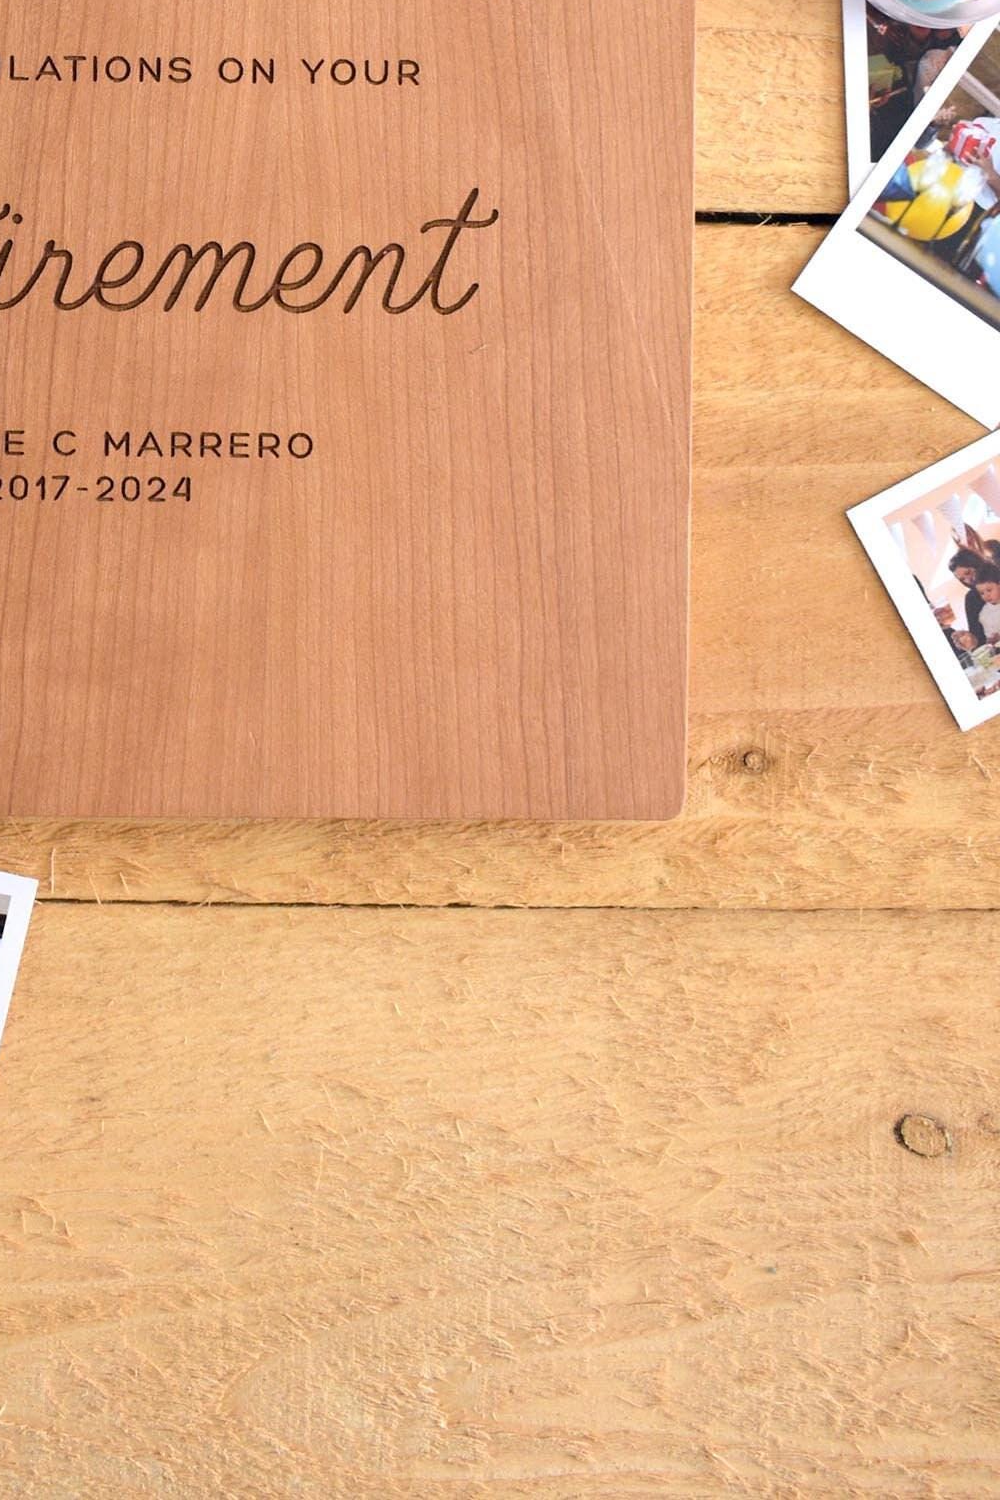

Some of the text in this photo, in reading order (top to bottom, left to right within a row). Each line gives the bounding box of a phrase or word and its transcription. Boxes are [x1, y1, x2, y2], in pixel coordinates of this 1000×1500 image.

[217, 56, 276, 85] ON
[300, 58, 422, 87] YOUR
[52, 429, 78, 457] C
[103, 430, 315, 460] MARRERO
